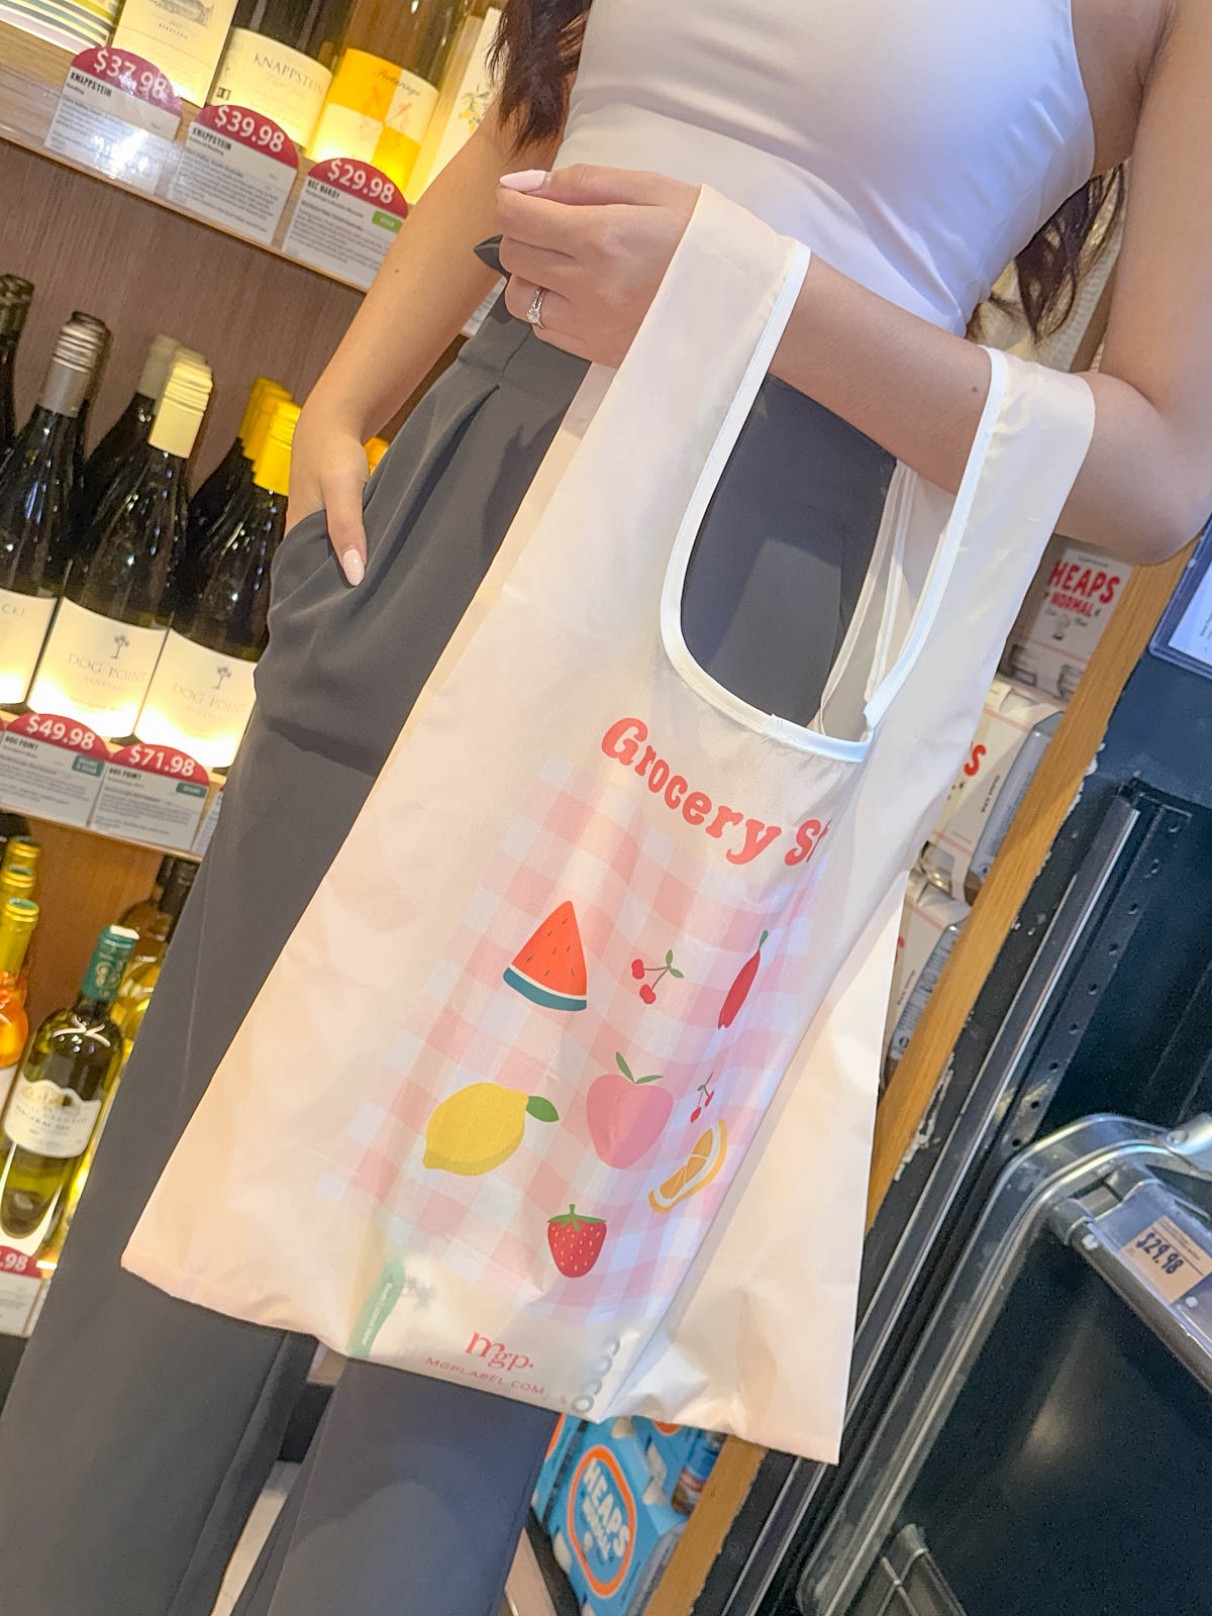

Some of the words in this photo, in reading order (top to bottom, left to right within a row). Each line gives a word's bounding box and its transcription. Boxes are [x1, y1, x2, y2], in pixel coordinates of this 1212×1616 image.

[70, 71, 113, 98] KNAPPSTEIN
[93, 48, 169, 99] $3798
[253, 52, 325, 97] KNAPPSTEIN
[191, 127, 232, 152] KNAPPSTEIN
[214, 105, 285, 153] $39.98
[327, 157, 396, 204] $29.98
[1047, 559, 1120, 604] HEAPS
[1050, 591, 1095, 617] NORMAL
[68, 652, 102, 674] DOG
[108, 666, 148, 684] POINT
[26, 714, 96, 751] $49.98
[128, 745, 196, 778] $71.98
[601, 717, 782, 866] Grocery
[784, 818, 832, 867] S
[1136, 1232, 1184, 1275] $29.98
[426, 1356, 546, 1395] MGPLABEL.COM
[583, 1457, 630, 1558] HEAPS
